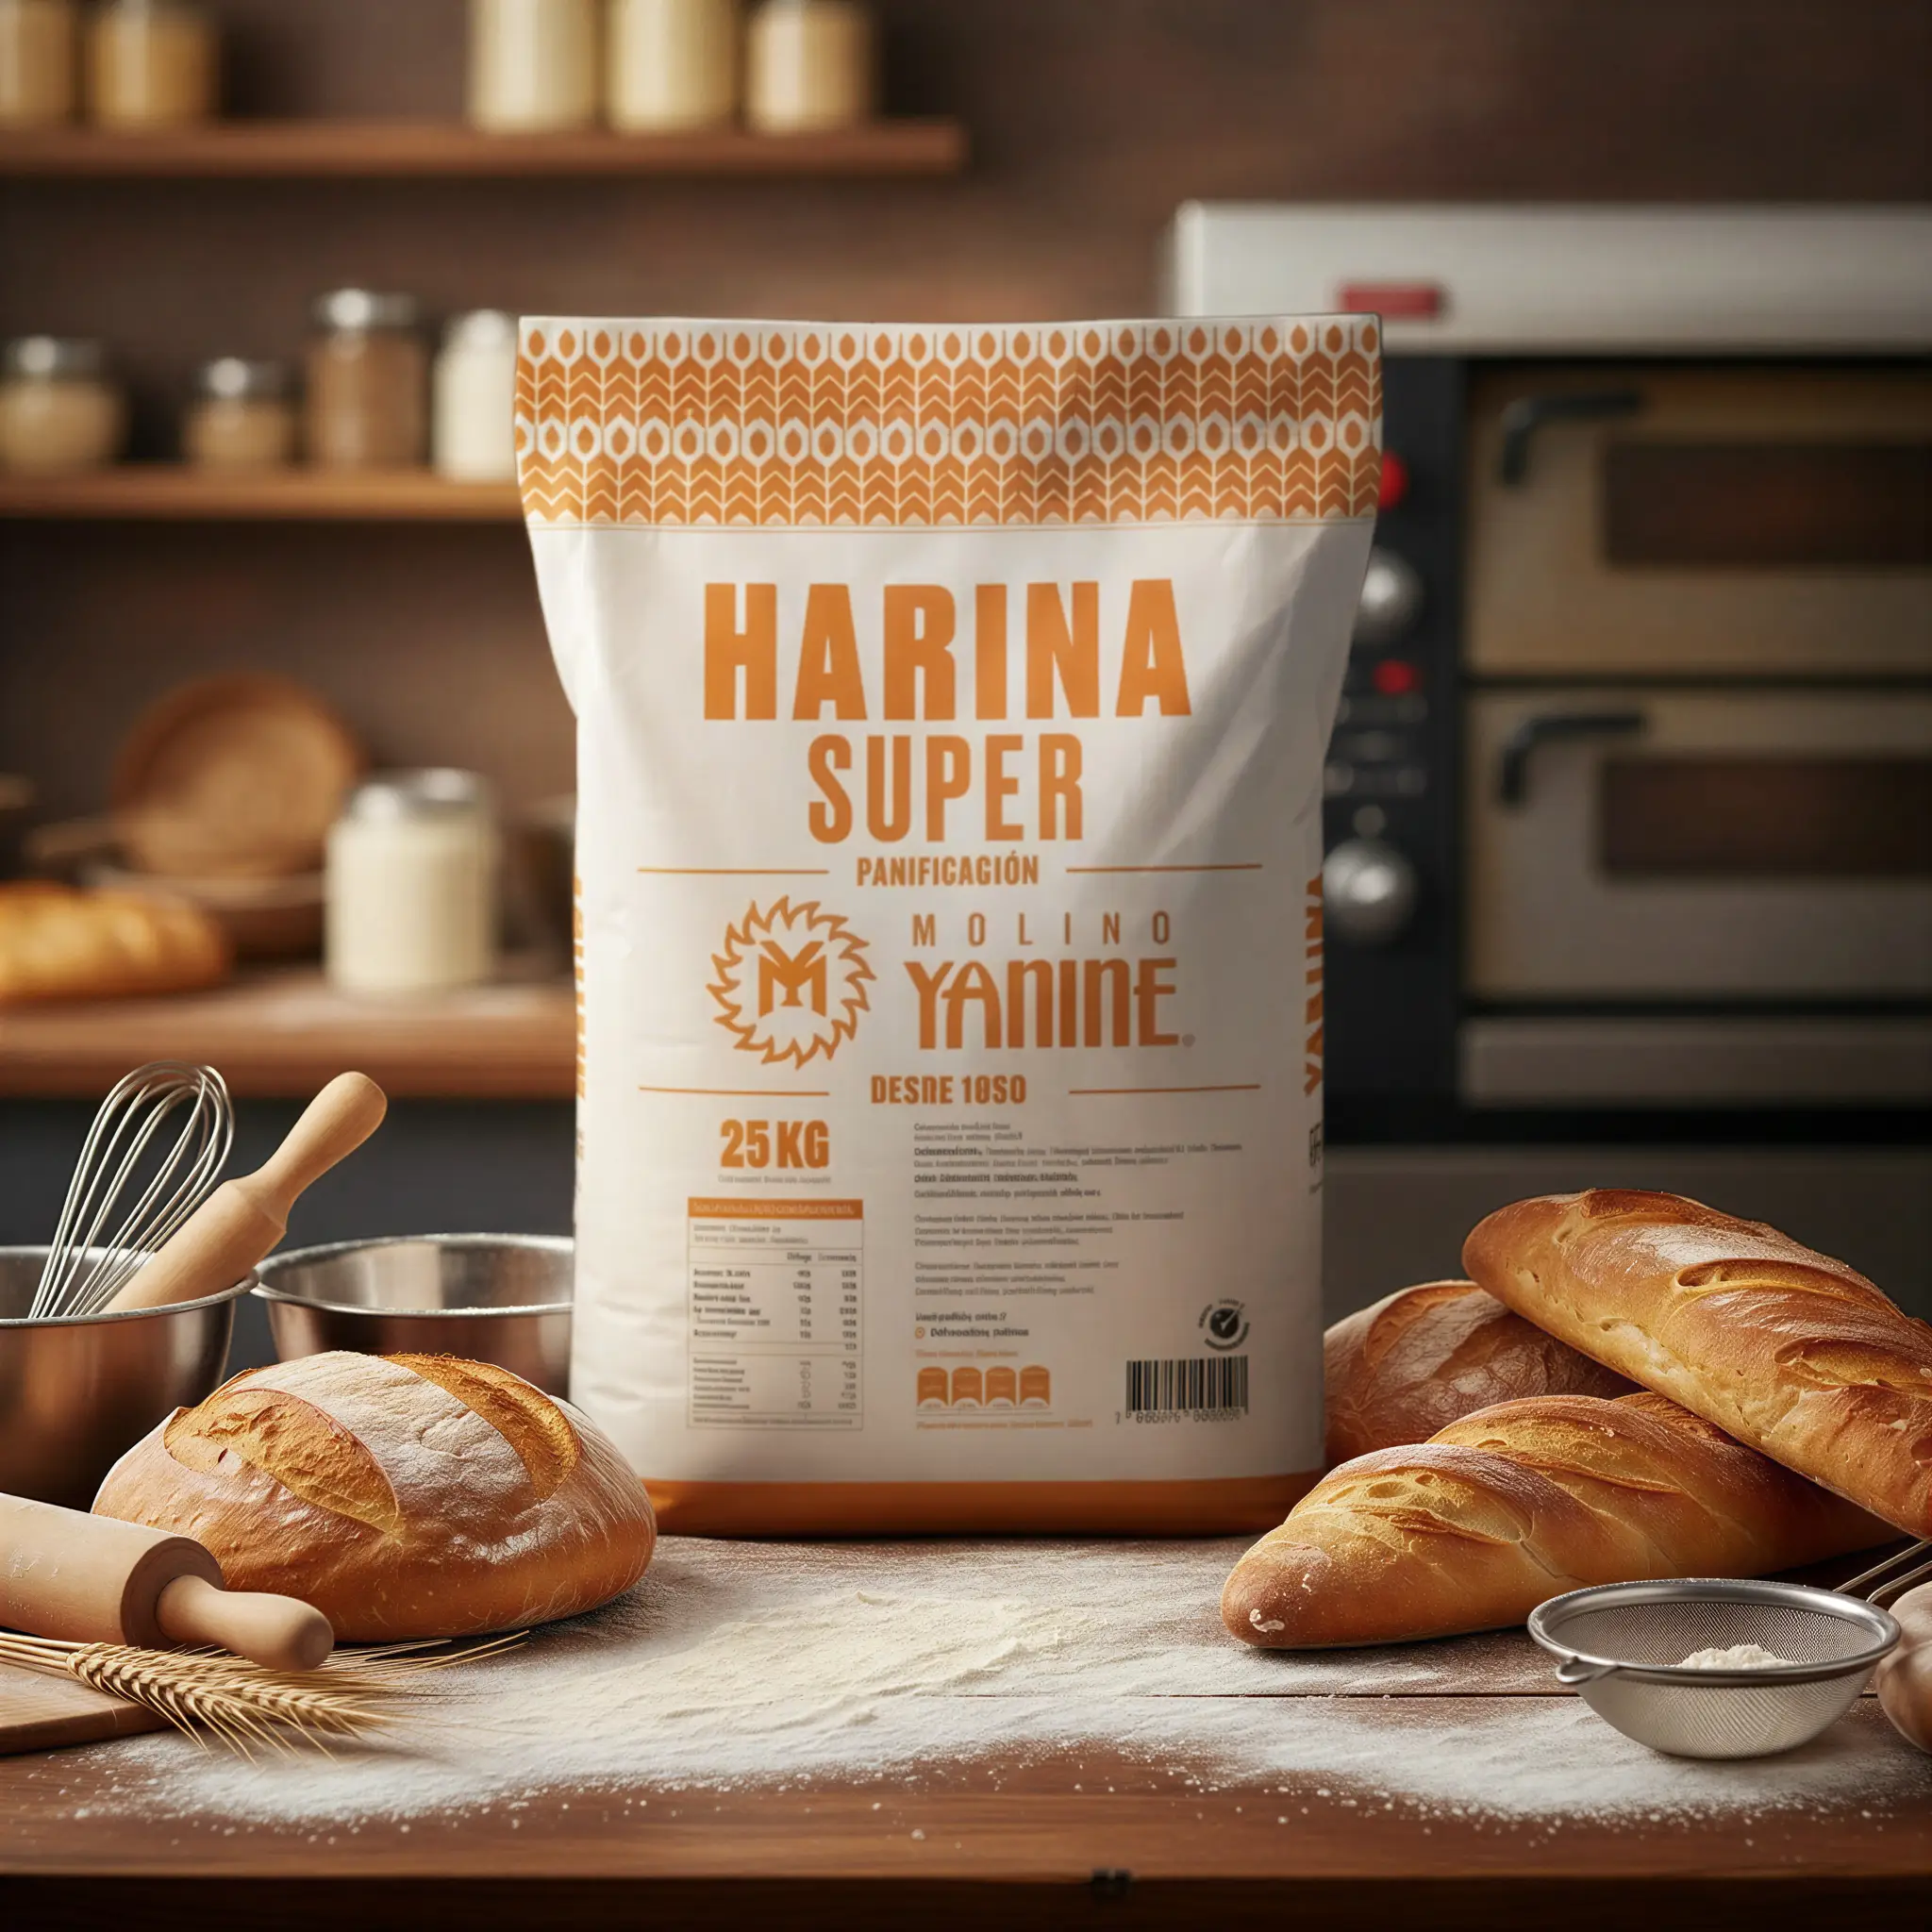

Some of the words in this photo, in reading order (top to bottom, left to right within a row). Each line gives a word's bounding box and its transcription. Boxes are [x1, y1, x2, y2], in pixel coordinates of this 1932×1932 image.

[705, 579, 1191, 721] HARINA
[808, 734, 1083, 842] SUPER
[913, 911, 1170, 945] MOLINO
[721, 1120, 770, 1168] 25
[776, 1121, 830, 1168] KG
